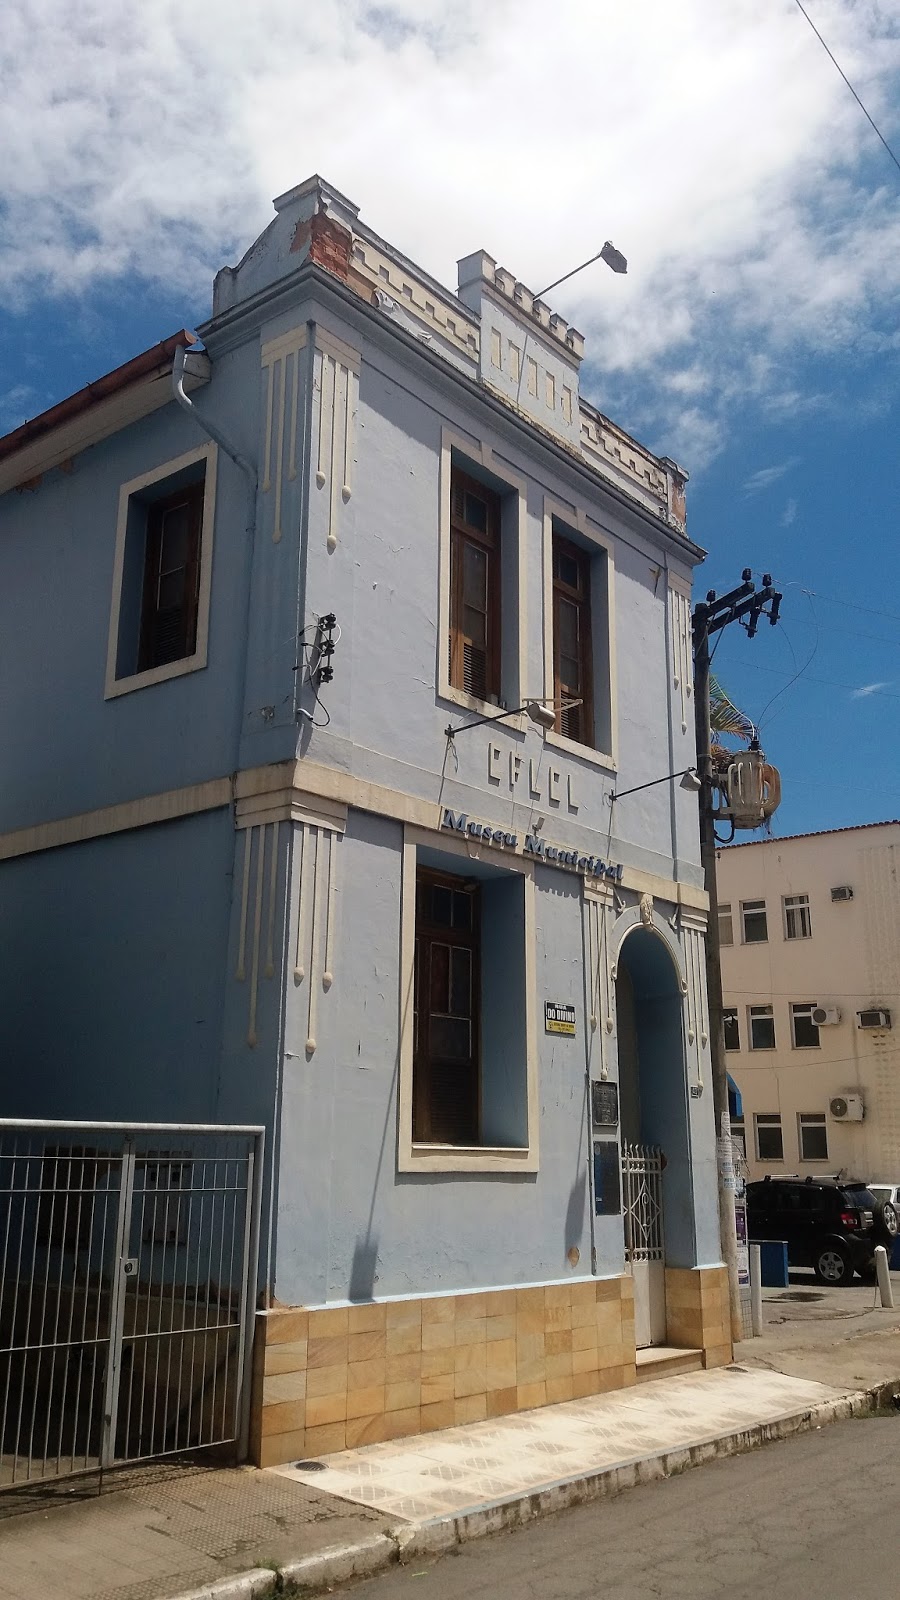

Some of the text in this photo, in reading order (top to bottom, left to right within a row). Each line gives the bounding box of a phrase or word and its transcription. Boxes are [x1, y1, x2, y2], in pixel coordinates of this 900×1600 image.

[444, 809, 624, 880] Museu Municipal
[547, 1008, 556, 1019] DO
